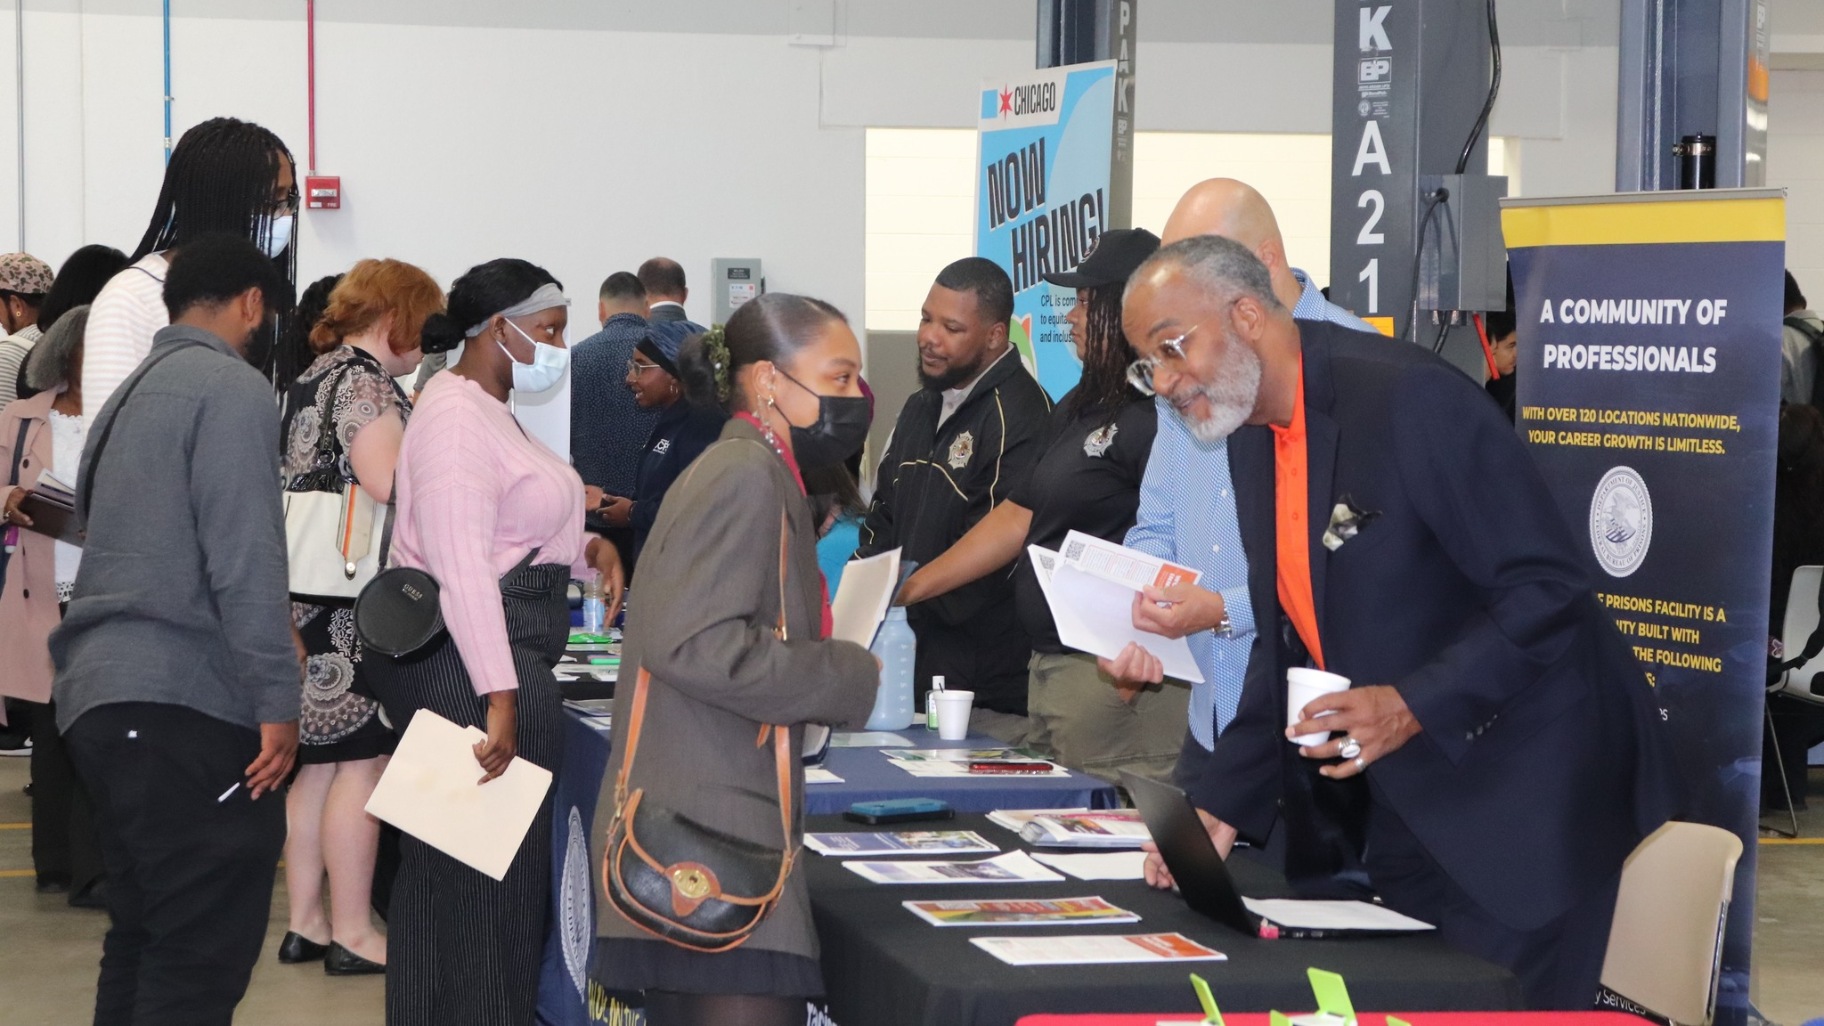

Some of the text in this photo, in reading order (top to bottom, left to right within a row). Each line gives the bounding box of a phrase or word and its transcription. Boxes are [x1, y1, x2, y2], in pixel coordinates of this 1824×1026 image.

[1014, 81, 1056, 116] CHICAGO
[987, 136, 1046, 230] NOW
[1041, 294, 1053, 307] CPL
[1055, 294, 1060, 306] is
[1540, 298, 1728, 325] A COMMUNITY OF
[1040, 314, 1047, 325] to
[1040, 330, 1052, 343] and
[1543, 344, 1717, 373] PROFESSIONALS
[1522, 406, 1741, 432] WITH OVER 120 LOCATIONS NATIONWIDE,
[1528, 429, 1726, 455] YOUR CAREER GROWTH IS LIMITLESS.
[1606, 594, 1653, 613] PRISONS
[1655, 600, 1702, 619] FACILITY
[1703, 606, 1714, 621] IS
[1716, 608, 1726, 623] A
[1638, 622, 1669, 640] BUILT
[1672, 627, 1700, 644] WITH
[1632, 646, 1722, 673] THE FOLLOWING
